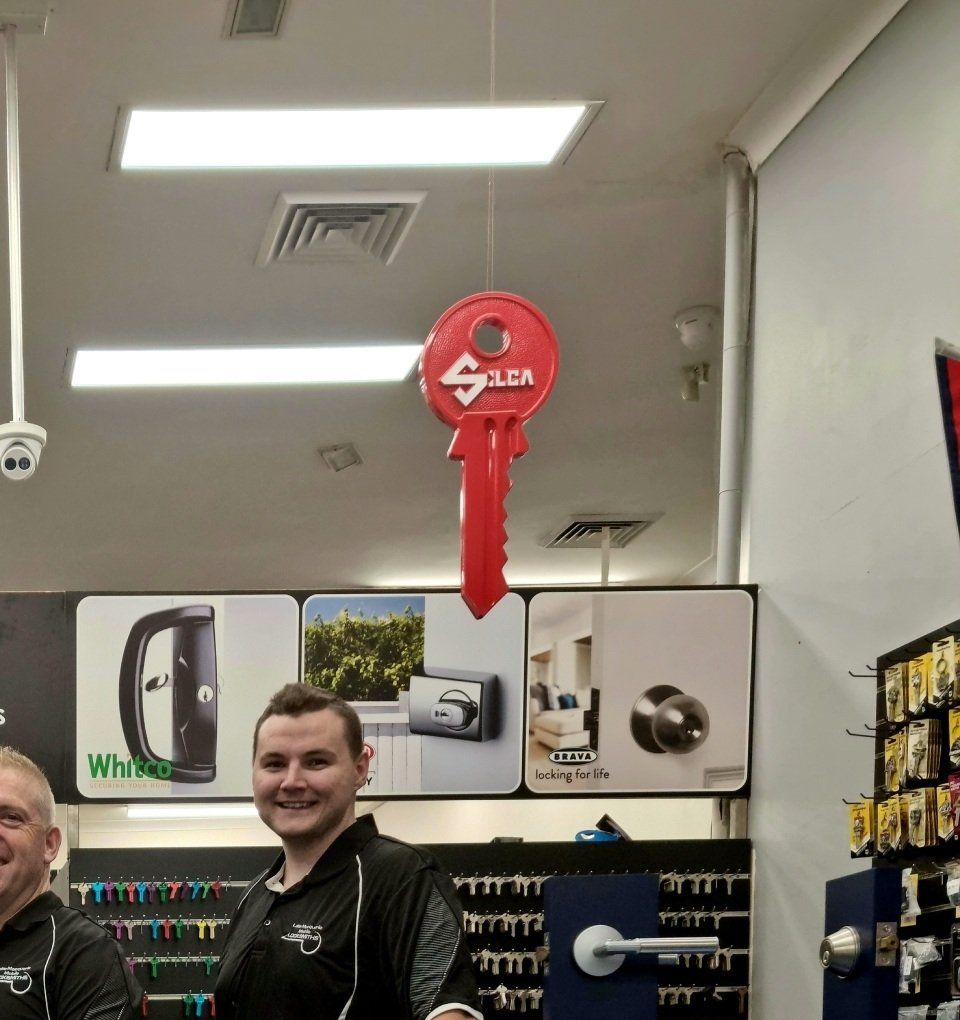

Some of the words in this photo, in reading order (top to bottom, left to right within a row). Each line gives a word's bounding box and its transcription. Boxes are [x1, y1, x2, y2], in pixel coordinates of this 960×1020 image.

[553, 752, 592, 761] BRAVA
[87, 751, 172, 780] Whitco
[535, 768, 572, 783] locking
[575, 768, 591, 779] for
[593, 768, 610, 779] life
